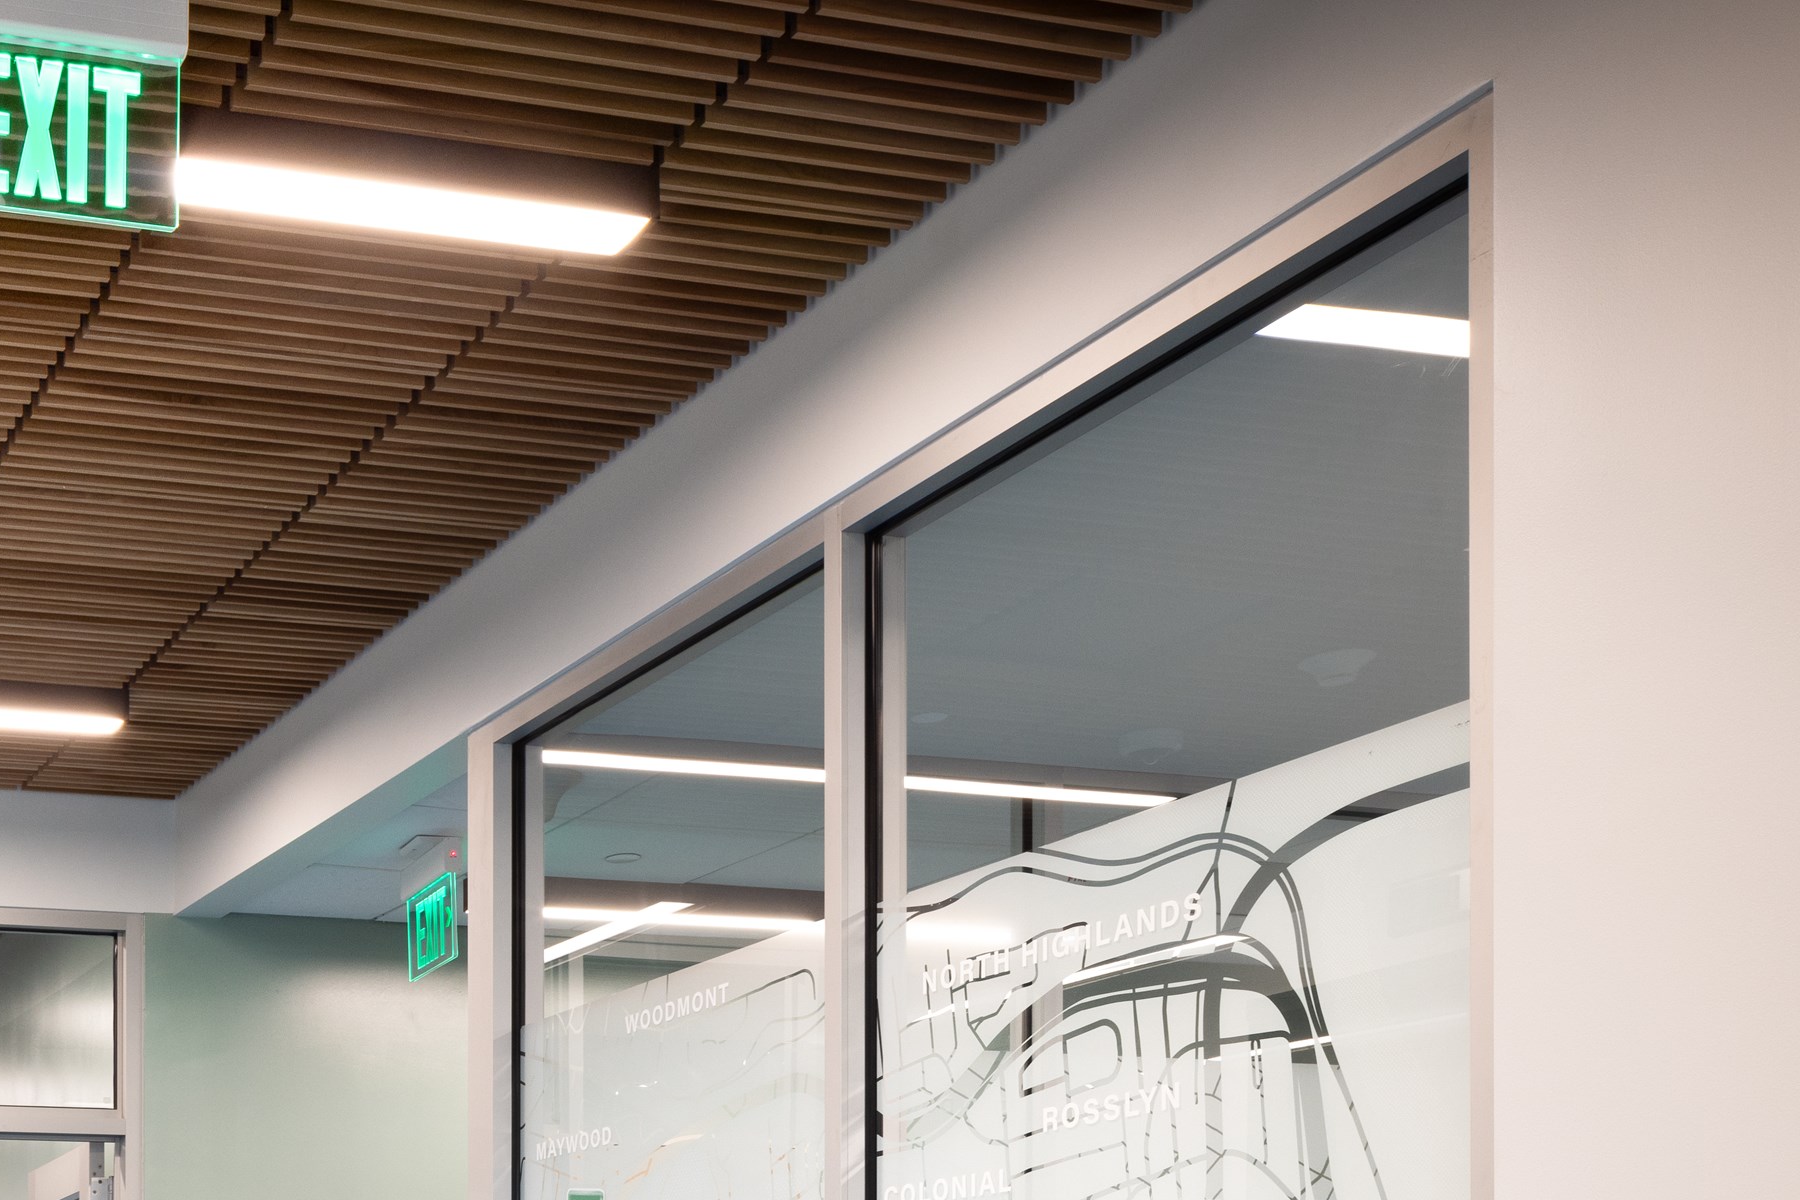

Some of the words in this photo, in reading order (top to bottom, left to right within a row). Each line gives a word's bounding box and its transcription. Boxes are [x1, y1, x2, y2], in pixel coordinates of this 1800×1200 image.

[416, 886, 446, 969] EXIT
[922, 949, 1010, 995] NORTH
[1022, 892, 1203, 968] HIGHLANDS
[624, 982, 729, 1034] WOODMONT
[1042, 1082, 1181, 1132] ROSSLYN
[536, 1127, 612, 1160] MAYWOOD
